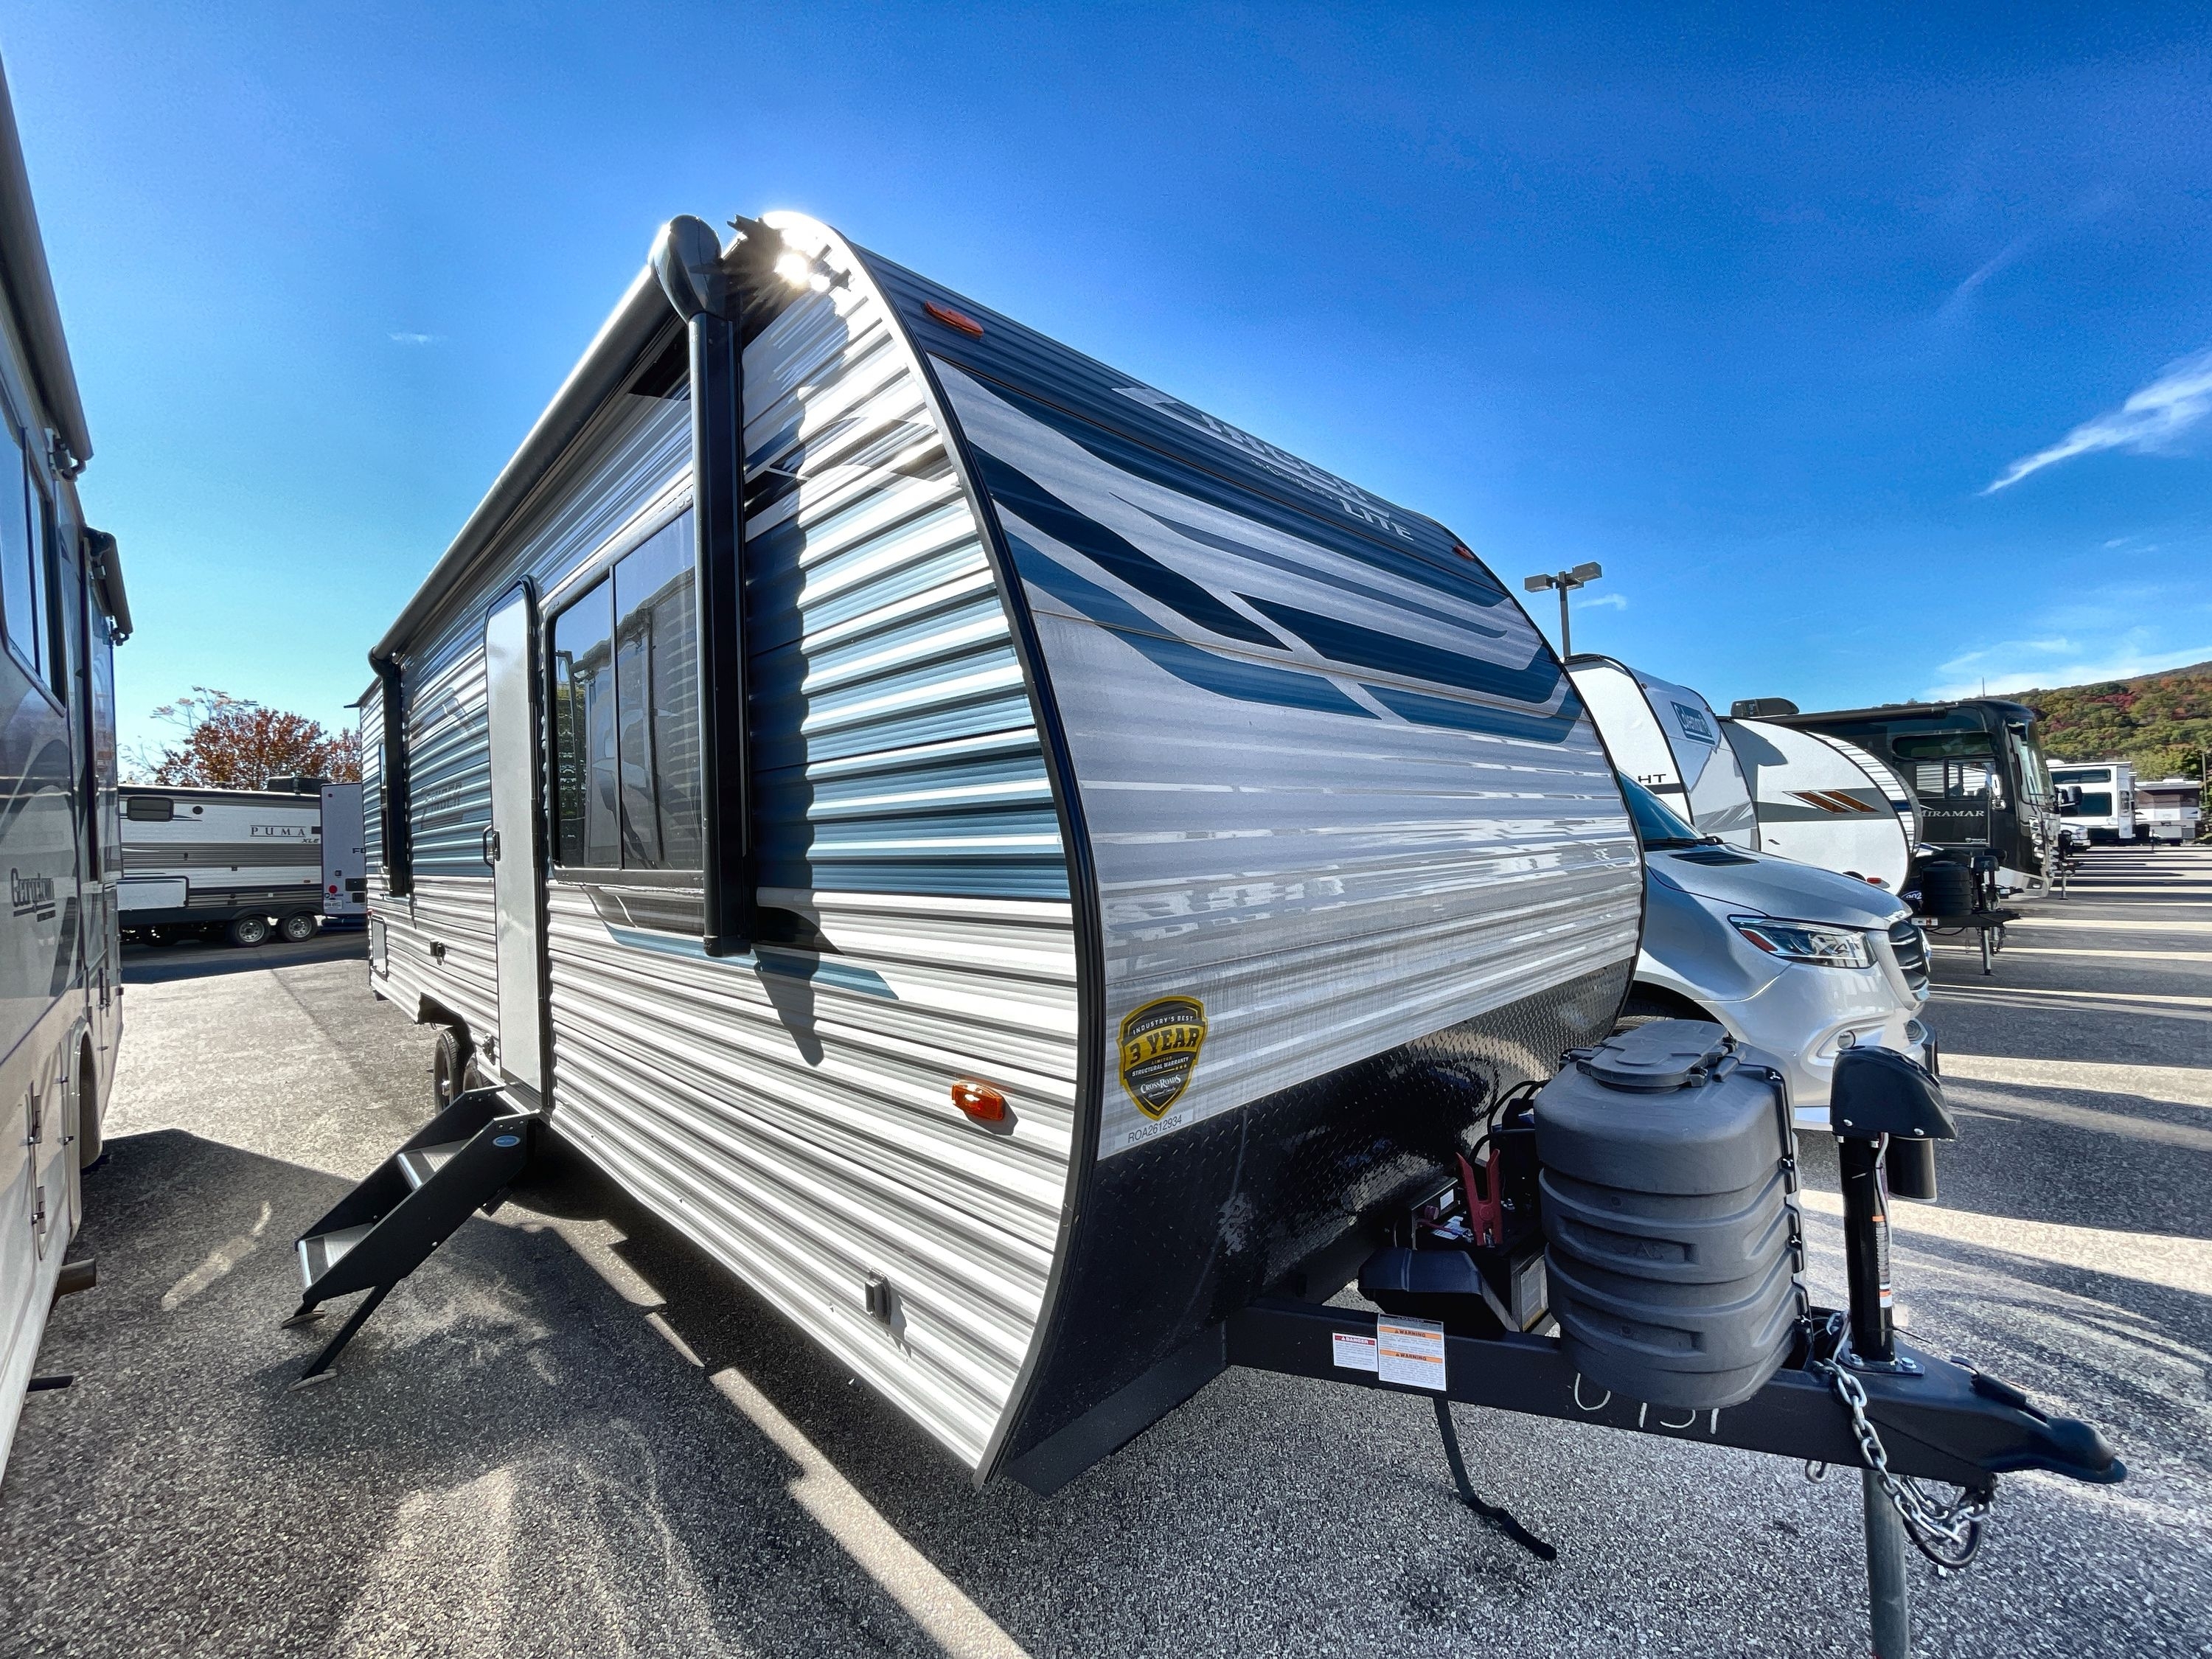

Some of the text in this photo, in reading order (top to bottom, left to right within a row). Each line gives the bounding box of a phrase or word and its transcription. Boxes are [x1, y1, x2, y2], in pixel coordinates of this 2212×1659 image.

[1339, 498, 1414, 541] LITE
[251, 827, 306, 837] PUMA
[1133, 1016, 1175, 1035] INDUSTRY'S
[1130, 1027, 1200, 1065] 3 YEAR
[1132, 1056, 1189, 1077] STRUCTURAL WARRANTY
[1127, 1114, 1182, 1143] ROA2612934
[1346, 1337, 1369, 1345] DANGER
[1400, 1329, 1426, 1338] WARNING
[1401, 1352, 1427, 1361] WARNING
